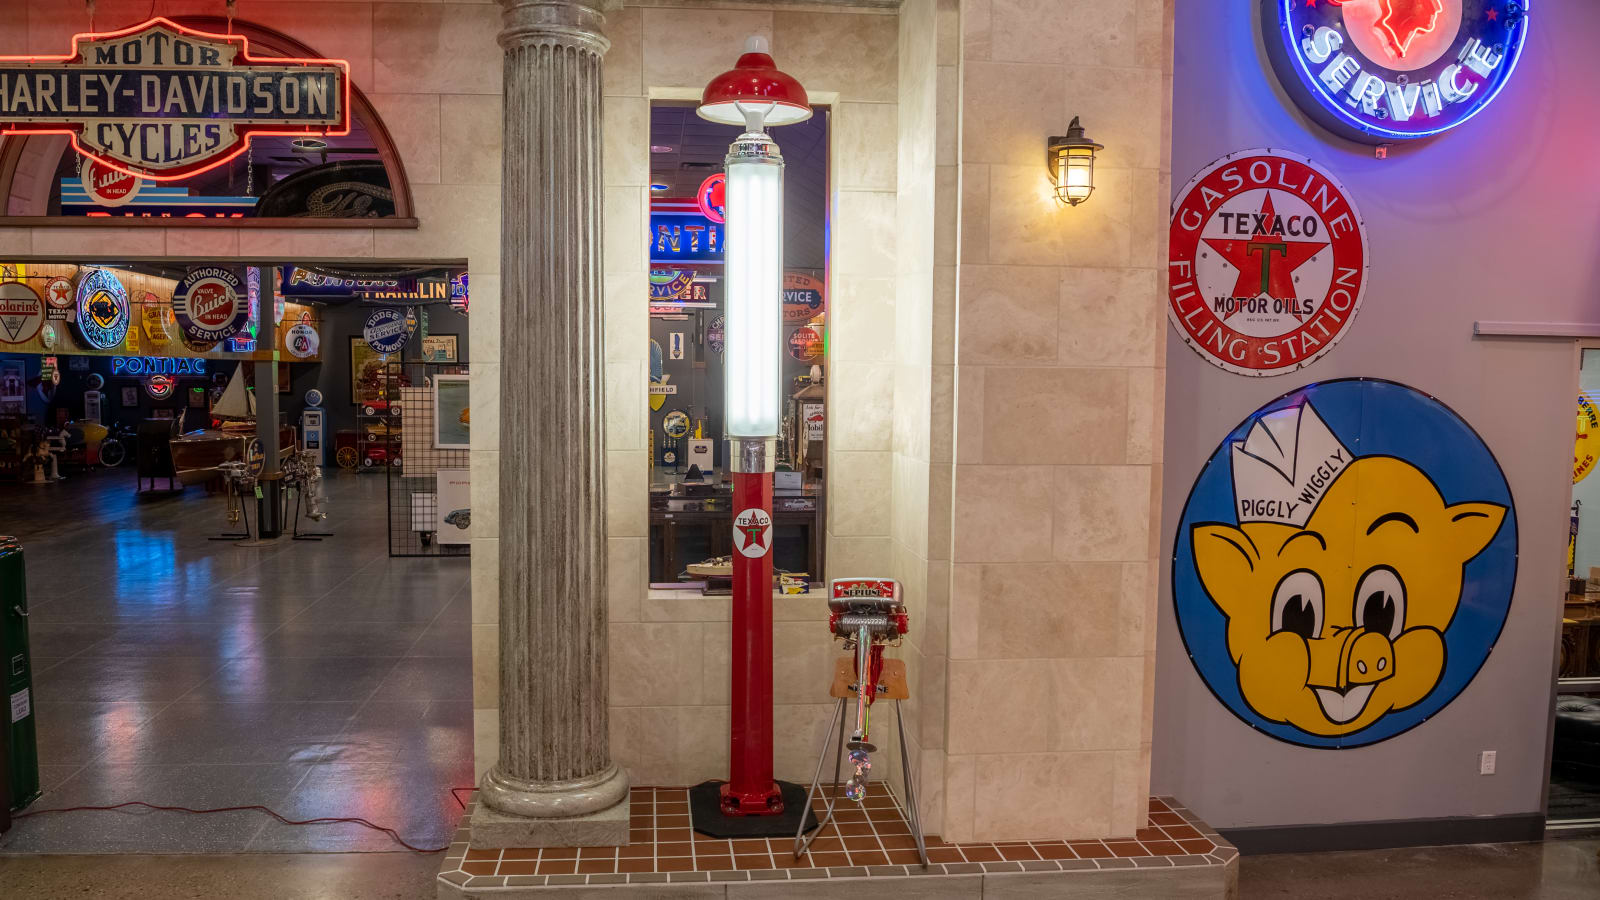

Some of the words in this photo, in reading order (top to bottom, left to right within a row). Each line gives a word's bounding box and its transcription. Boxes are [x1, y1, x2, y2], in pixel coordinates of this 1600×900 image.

[96, 31, 220, 67] MOTOR
[1302, 25, 1503, 122] SERVICE
[0, 73, 328, 115] HARLEY-DAVIDSON
[97, 122, 221, 165] CYCLES
[1180, 160, 1354, 240] GASOLINE
[1218, 212, 1318, 238] TEXACO
[183, 268, 239, 288] AUTHORIZED
[191, 284, 238, 320] Buick
[1170, 260, 1248, 361] FILLING
[1264, 266, 1359, 365] STATION
[1214, 296, 1268, 314] MOTOR
[1273, 298, 1315, 315] OILS
[188, 325, 237, 340] SERVICE
[368, 311, 399, 327] DODGE
[373, 333, 408, 352] PLYMOUTH
[113, 357, 205, 375] PONTIAC
[1241, 499, 1300, 519] PIGGLY
[1298, 448, 1345, 505] WIGGLY
[738, 517, 769, 525] TEXACO
